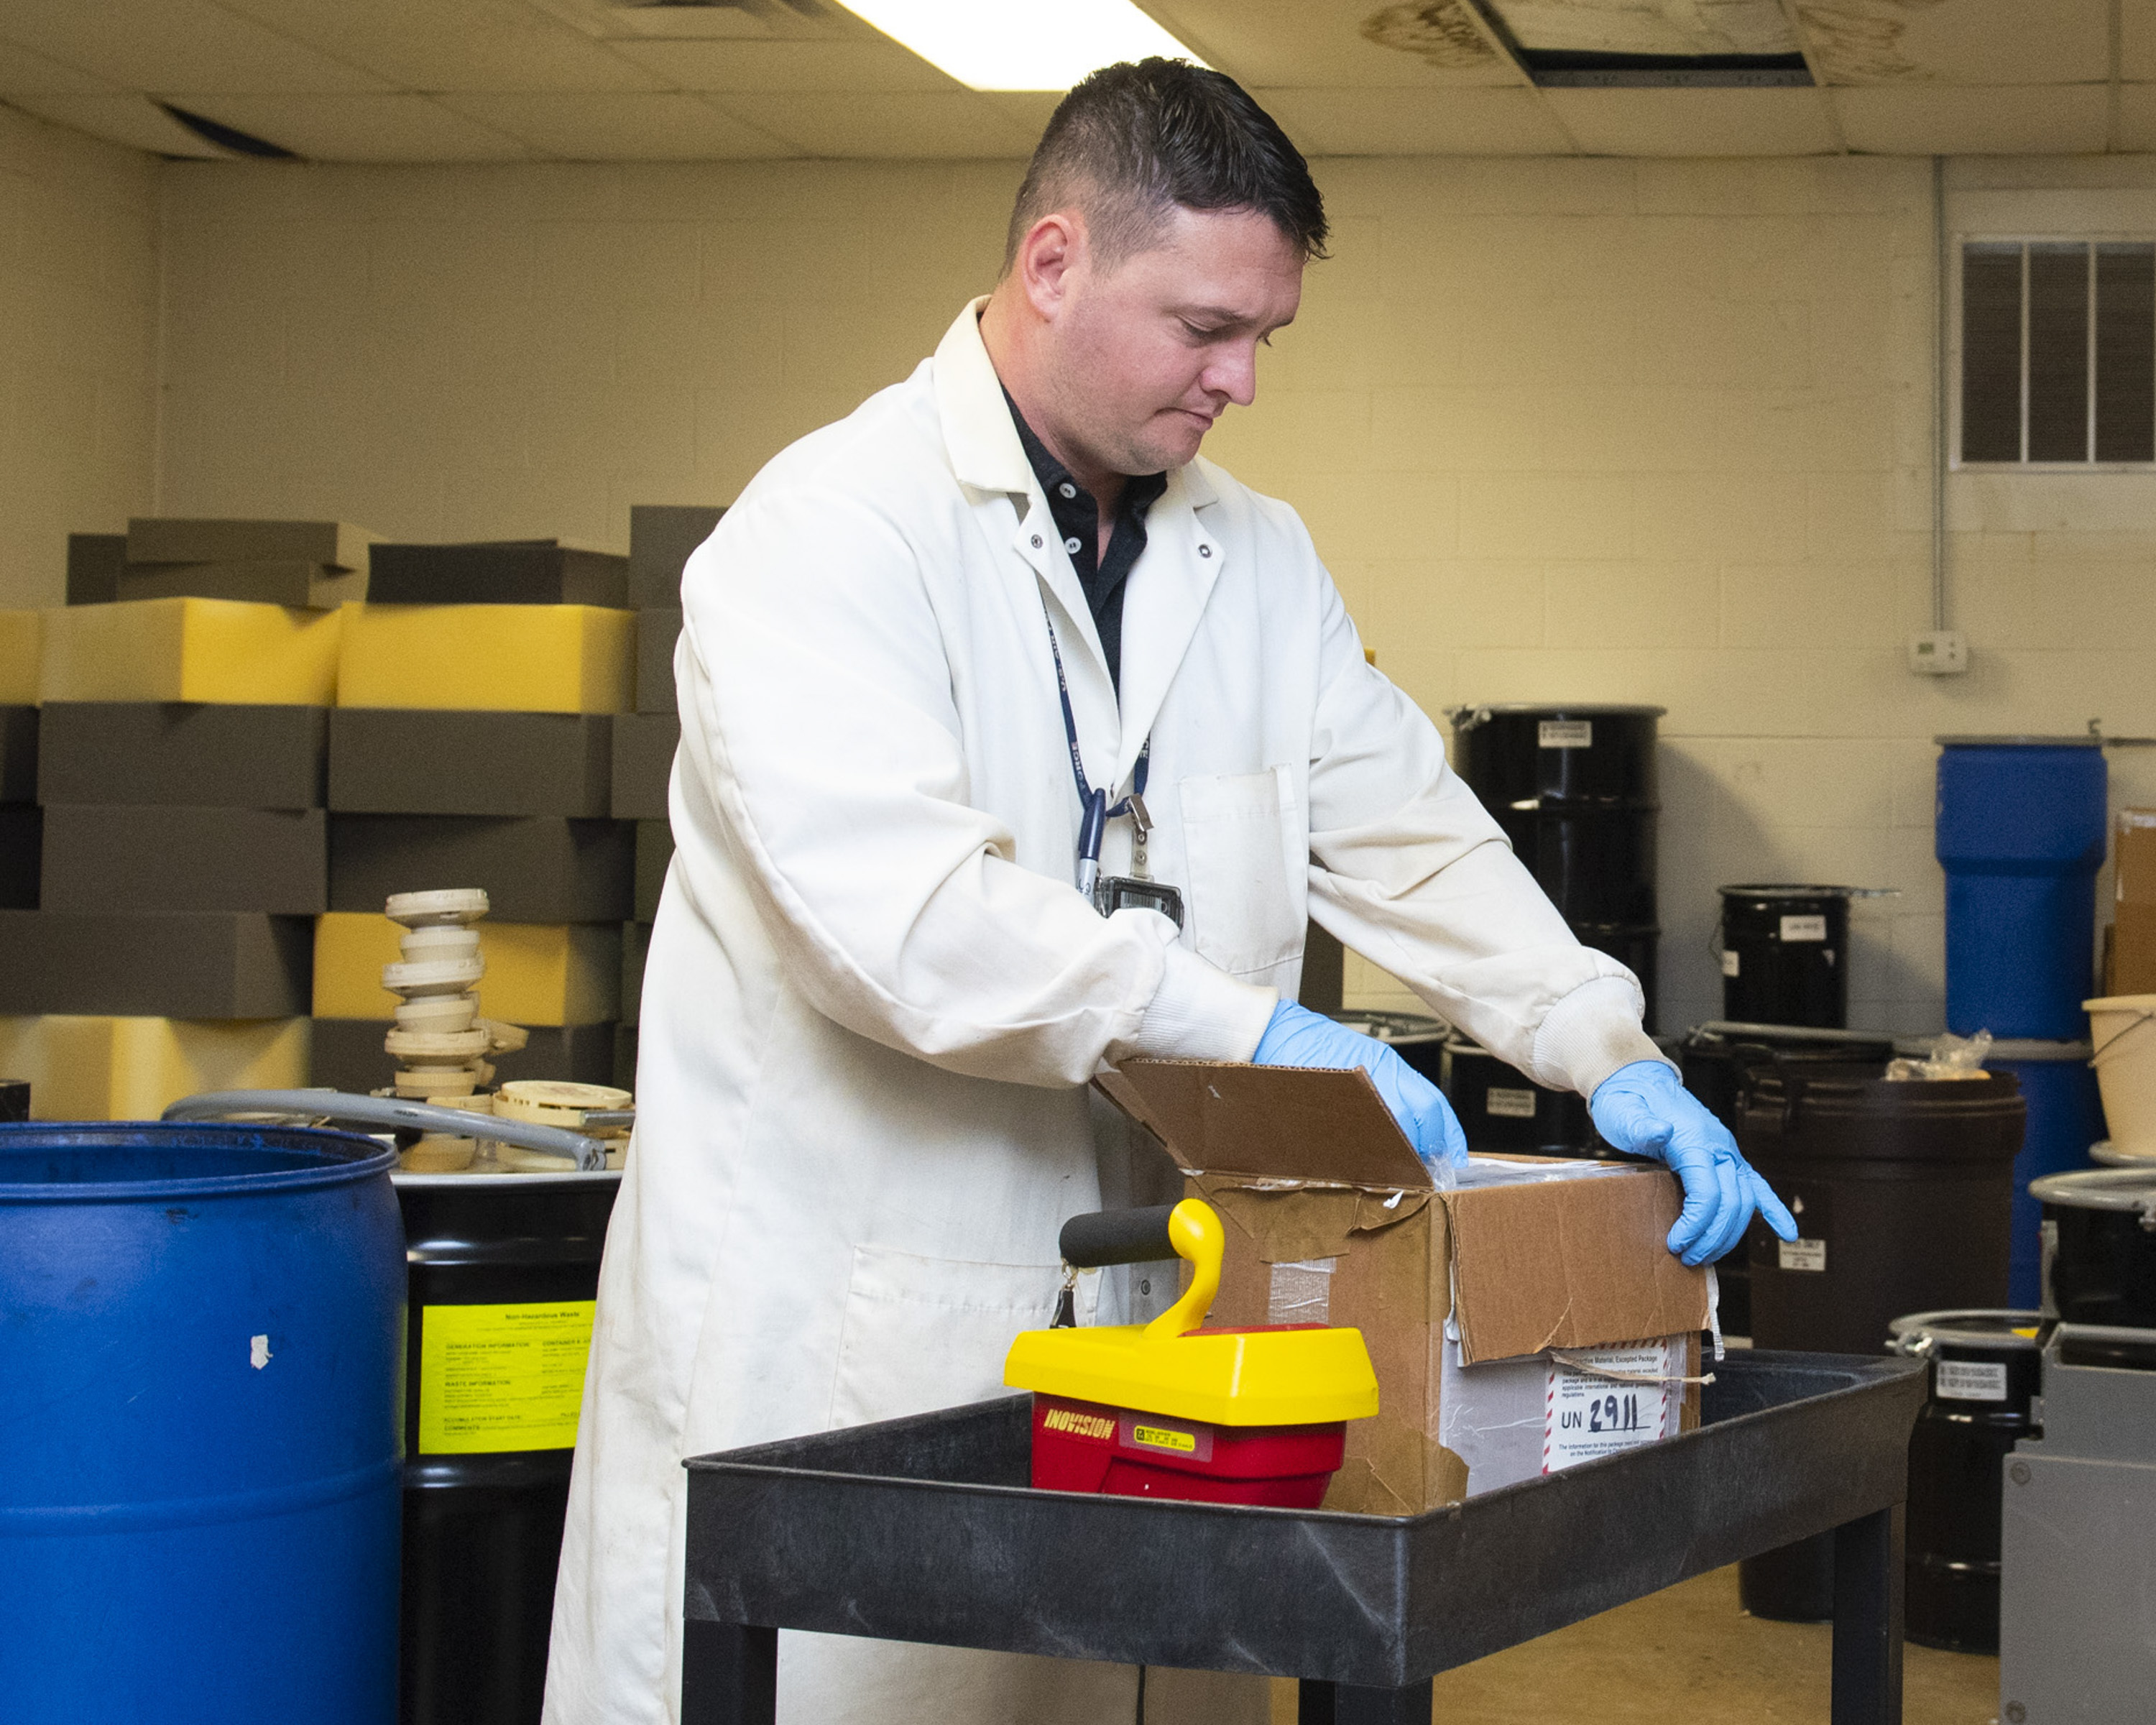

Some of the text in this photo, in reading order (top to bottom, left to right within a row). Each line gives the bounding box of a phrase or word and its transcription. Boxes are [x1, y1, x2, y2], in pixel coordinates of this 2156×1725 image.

[1639, 1355, 1658, 1363] Package
[1044, 1409, 1115, 1440] INOVISION
[1562, 1411, 1582, 1429] UN
[1590, 1394, 1638, 1432] 2911
